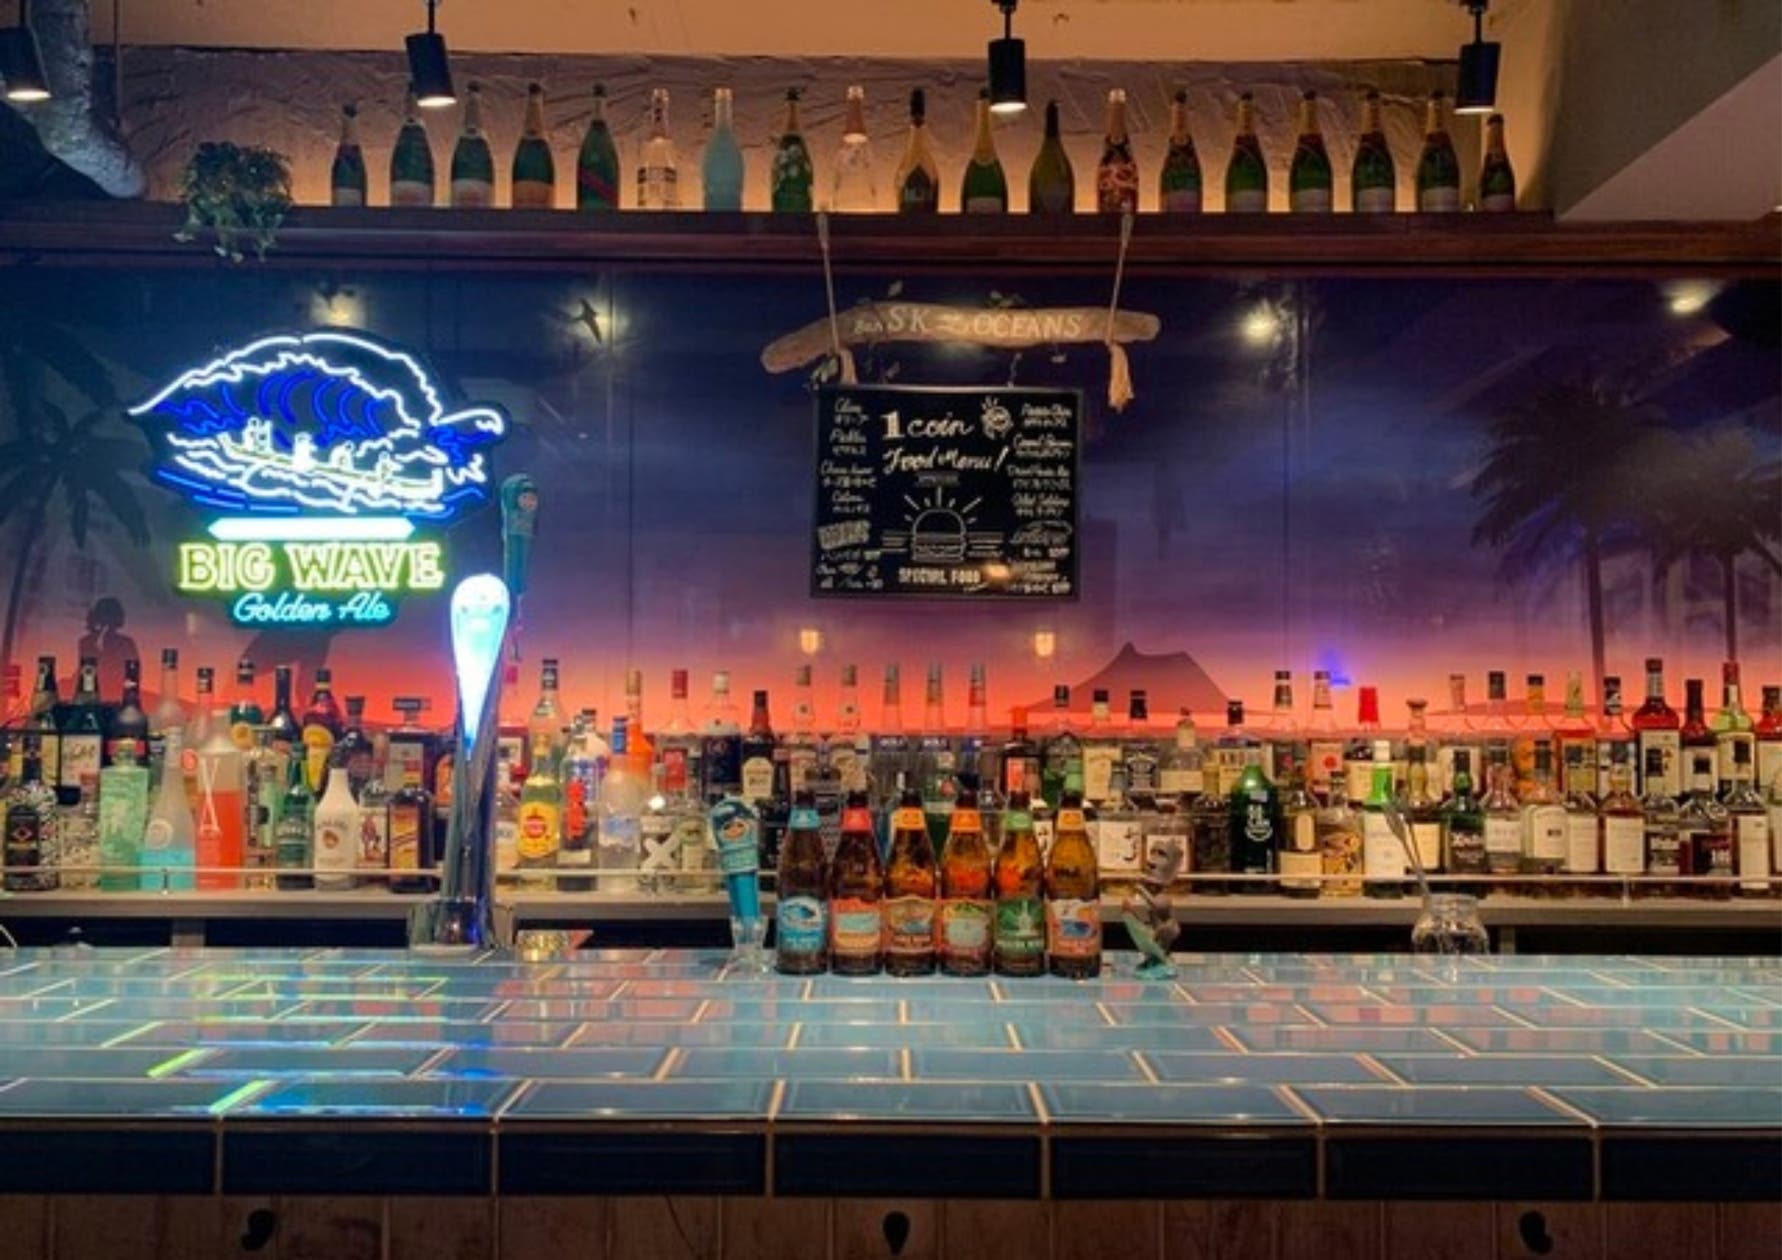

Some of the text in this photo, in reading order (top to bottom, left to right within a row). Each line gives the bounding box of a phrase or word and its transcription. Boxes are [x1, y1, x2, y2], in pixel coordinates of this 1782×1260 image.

[973, 311, 1083, 339] OCEANS
[881, 410, 905, 439] 1
[907, 411, 975, 438] coin
[882, 445, 939, 474] Food
[179, 543, 445, 590] BIG WAVE
[233, 592, 391, 622] Golden Ale
